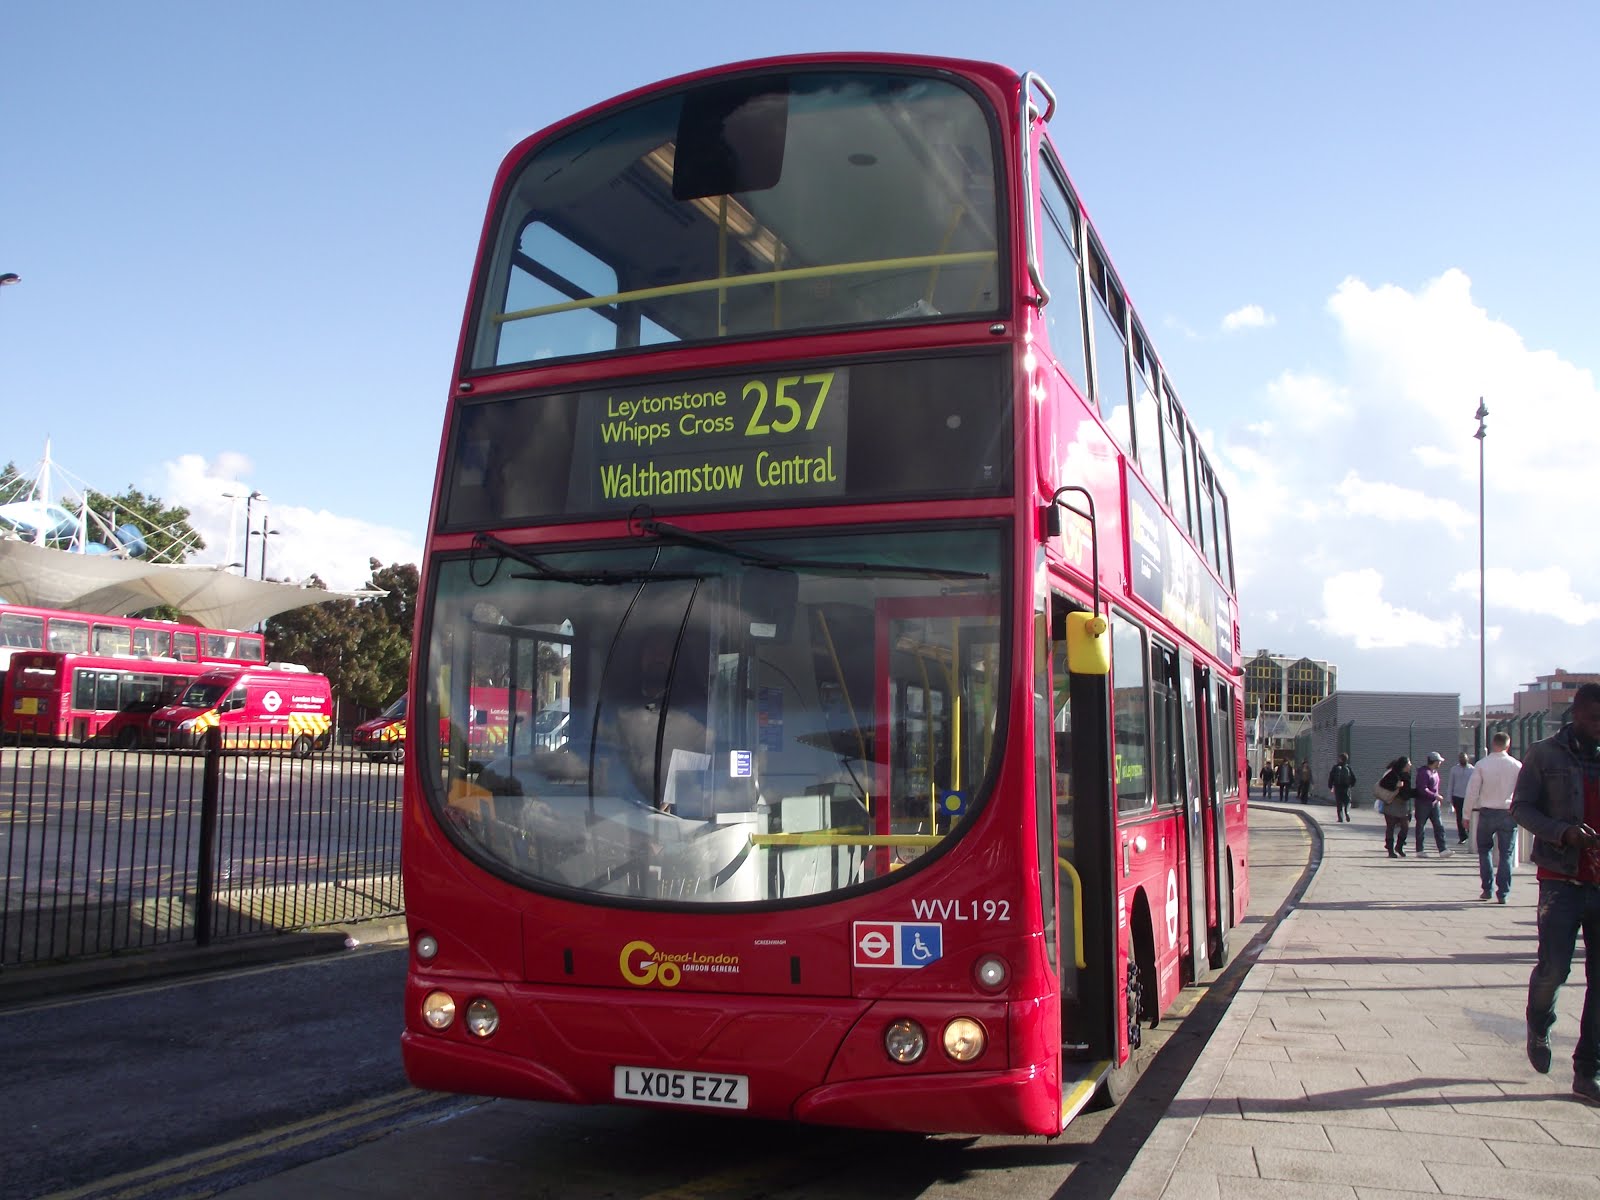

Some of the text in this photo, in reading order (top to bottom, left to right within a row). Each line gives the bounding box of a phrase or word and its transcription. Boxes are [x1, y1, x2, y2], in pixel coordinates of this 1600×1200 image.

[608, 390, 726, 421] Leytonstone
[742, 372, 835, 436] 257
[601, 414, 734, 446] Whipps Cross
[601, 446, 836, 499] Walthamstow Central
[911, 899, 1011, 921] WVL192
[619, 940, 739, 987] Go Ahead-London
[682, 964, 740, 973] LONDON GENERAL
[625, 1071, 738, 1103] LX05 EZZ
